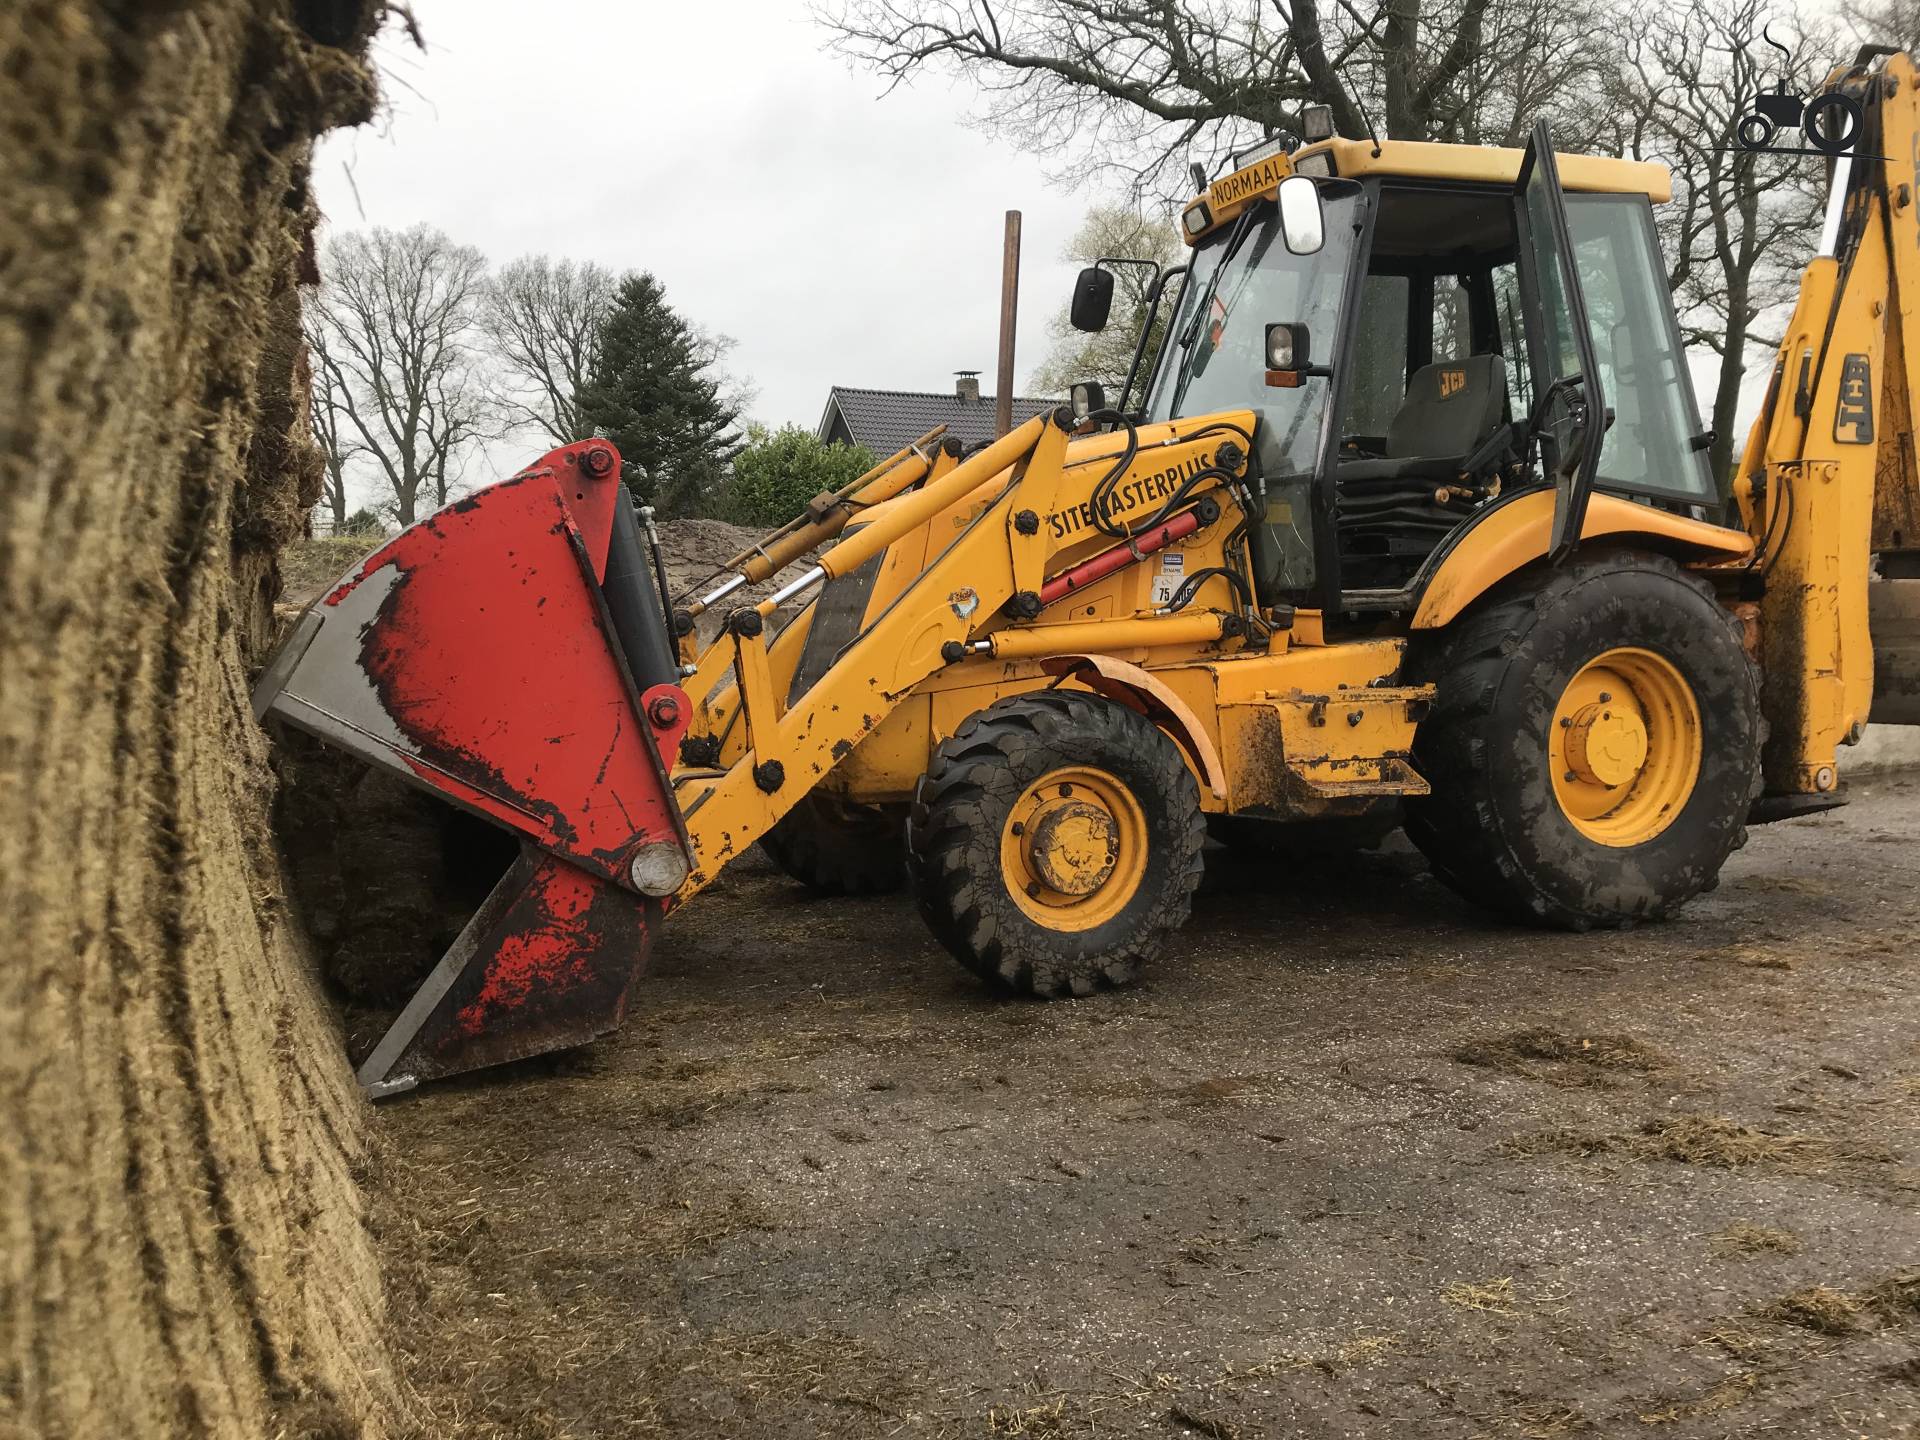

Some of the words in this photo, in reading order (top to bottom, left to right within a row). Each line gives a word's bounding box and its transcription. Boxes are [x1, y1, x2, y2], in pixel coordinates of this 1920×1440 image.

[1215, 161, 1285, 205] NORMAAL
[1441, 372, 1465, 397] JCB
[1159, 588, 1170, 601] 75
